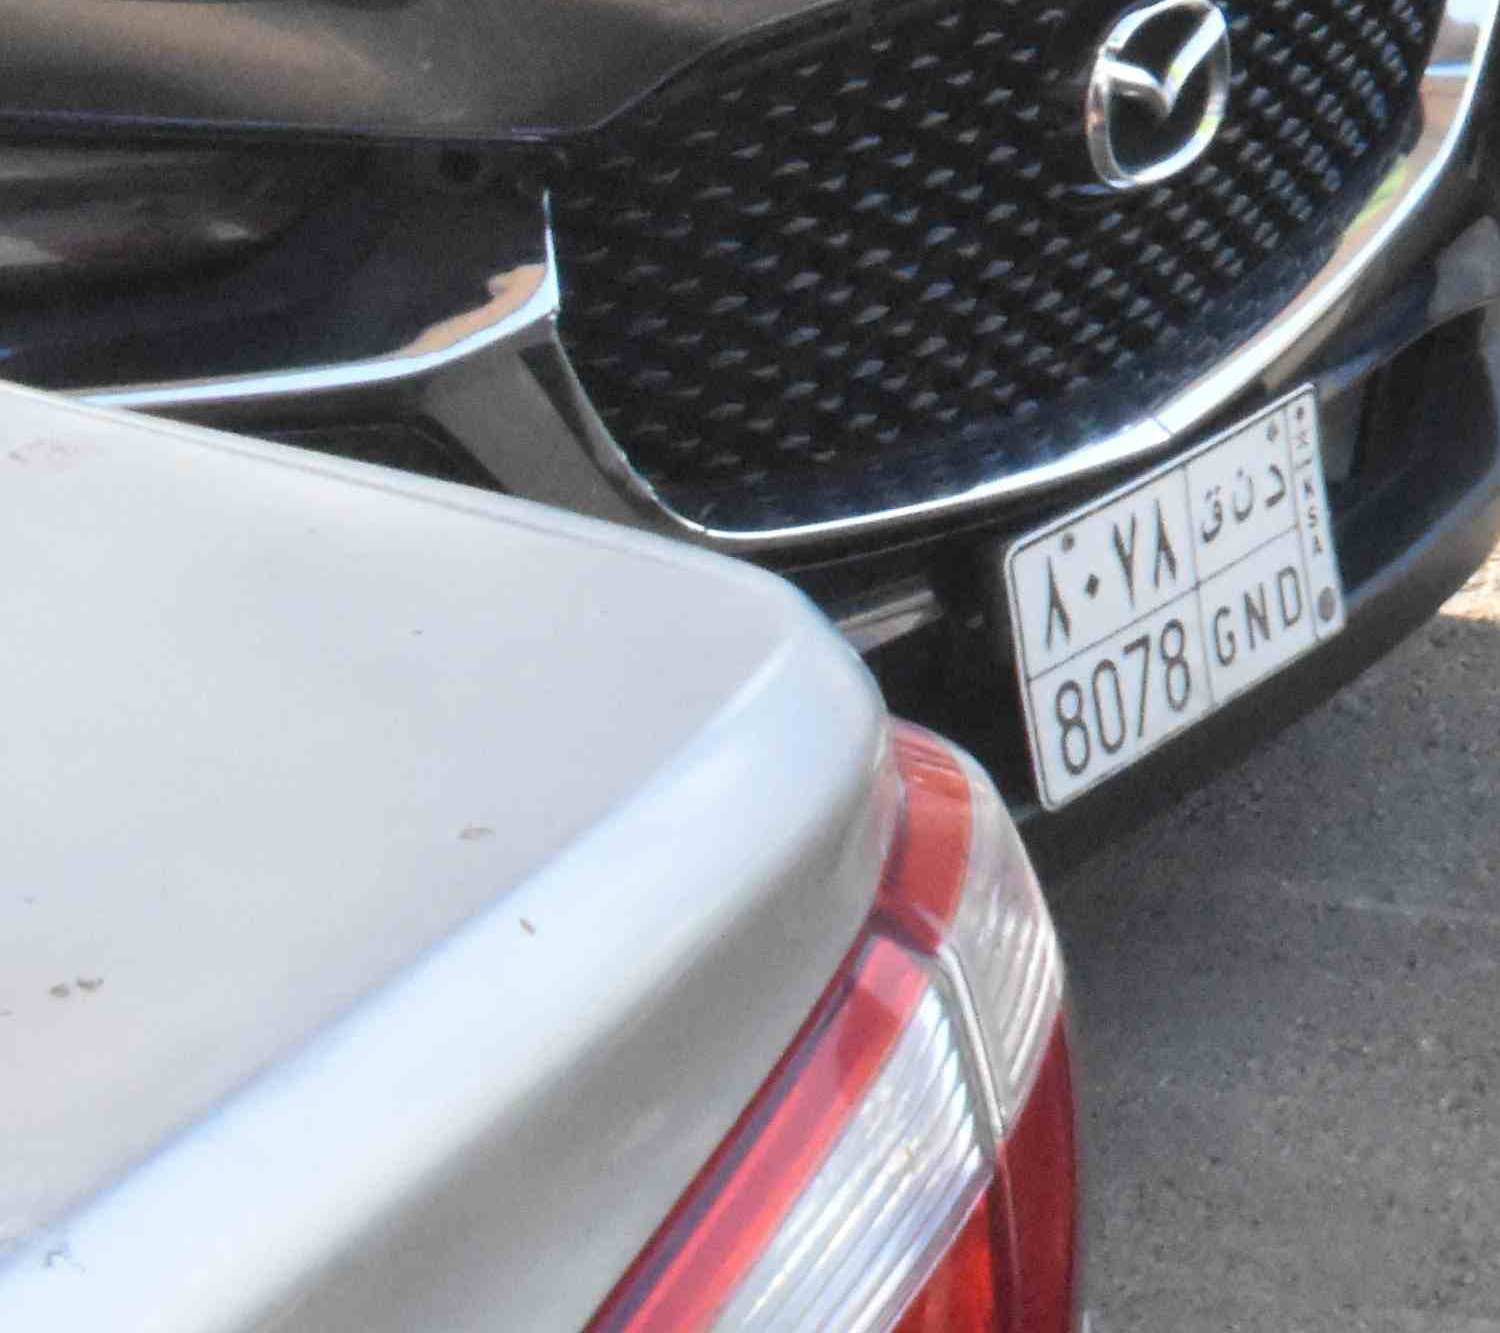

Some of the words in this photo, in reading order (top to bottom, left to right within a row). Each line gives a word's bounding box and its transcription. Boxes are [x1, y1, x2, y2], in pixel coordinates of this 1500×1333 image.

[1303, 479, 1323, 555] KSA
[1054, 617, 1192, 777] 8078
[1213, 564, 1303, 667] GND
